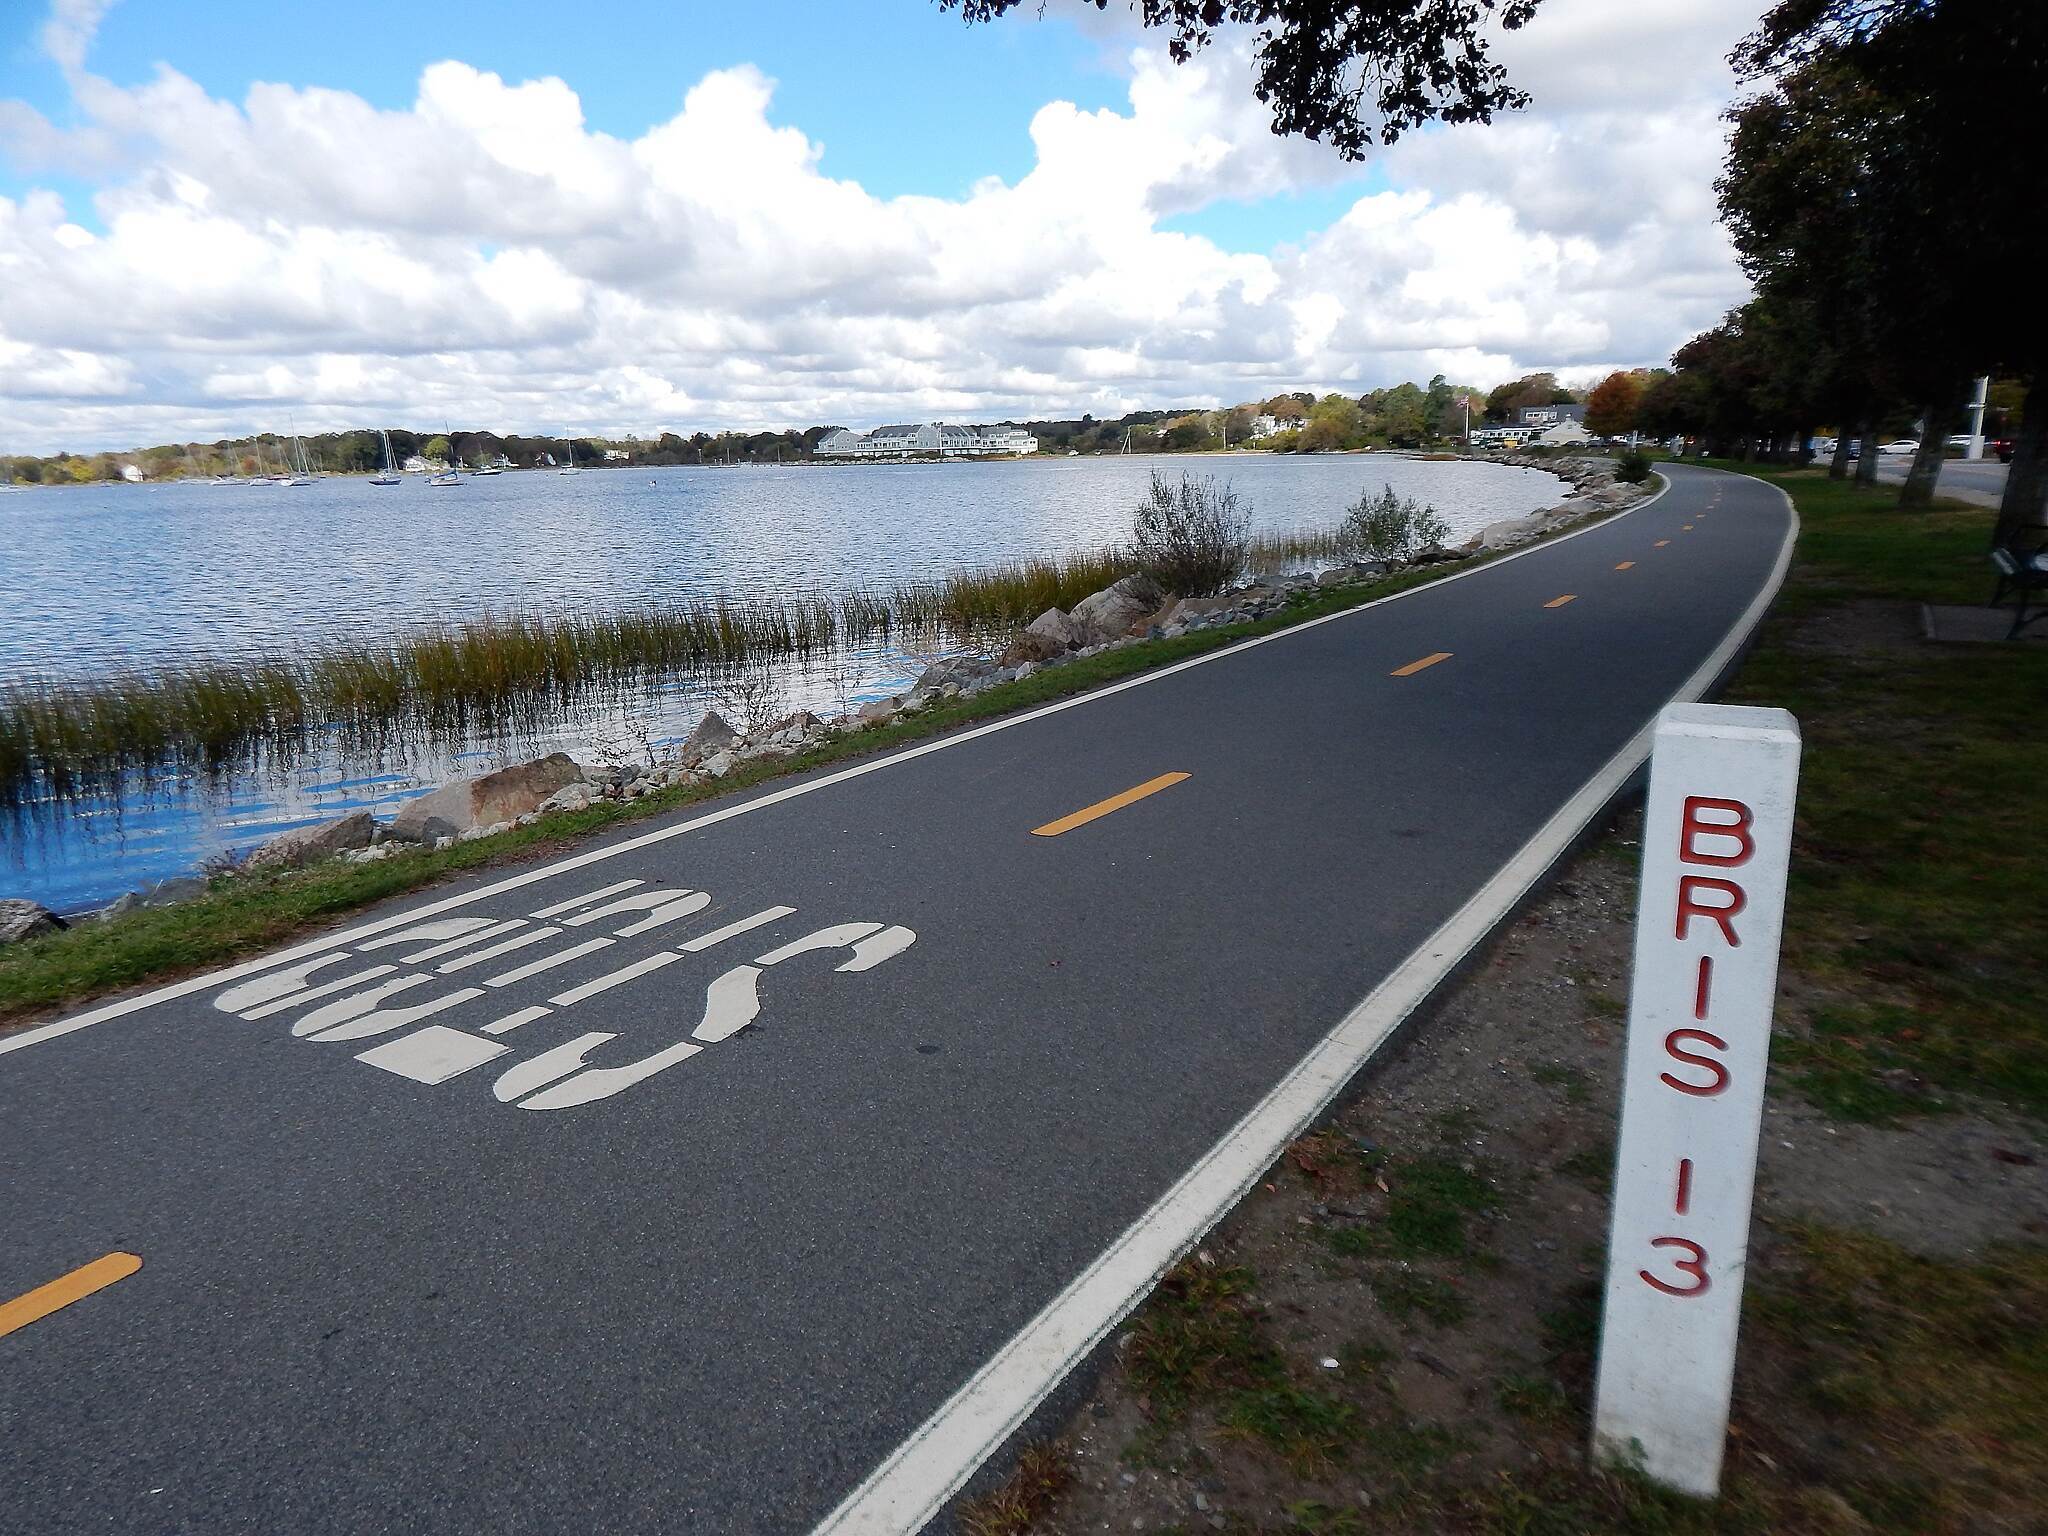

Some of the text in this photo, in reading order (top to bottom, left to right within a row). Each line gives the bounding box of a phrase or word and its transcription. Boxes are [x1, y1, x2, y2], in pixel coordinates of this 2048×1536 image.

[213, 878, 917, 1111] STOP
[1639, 795, 1754, 1297] BRIS 13
